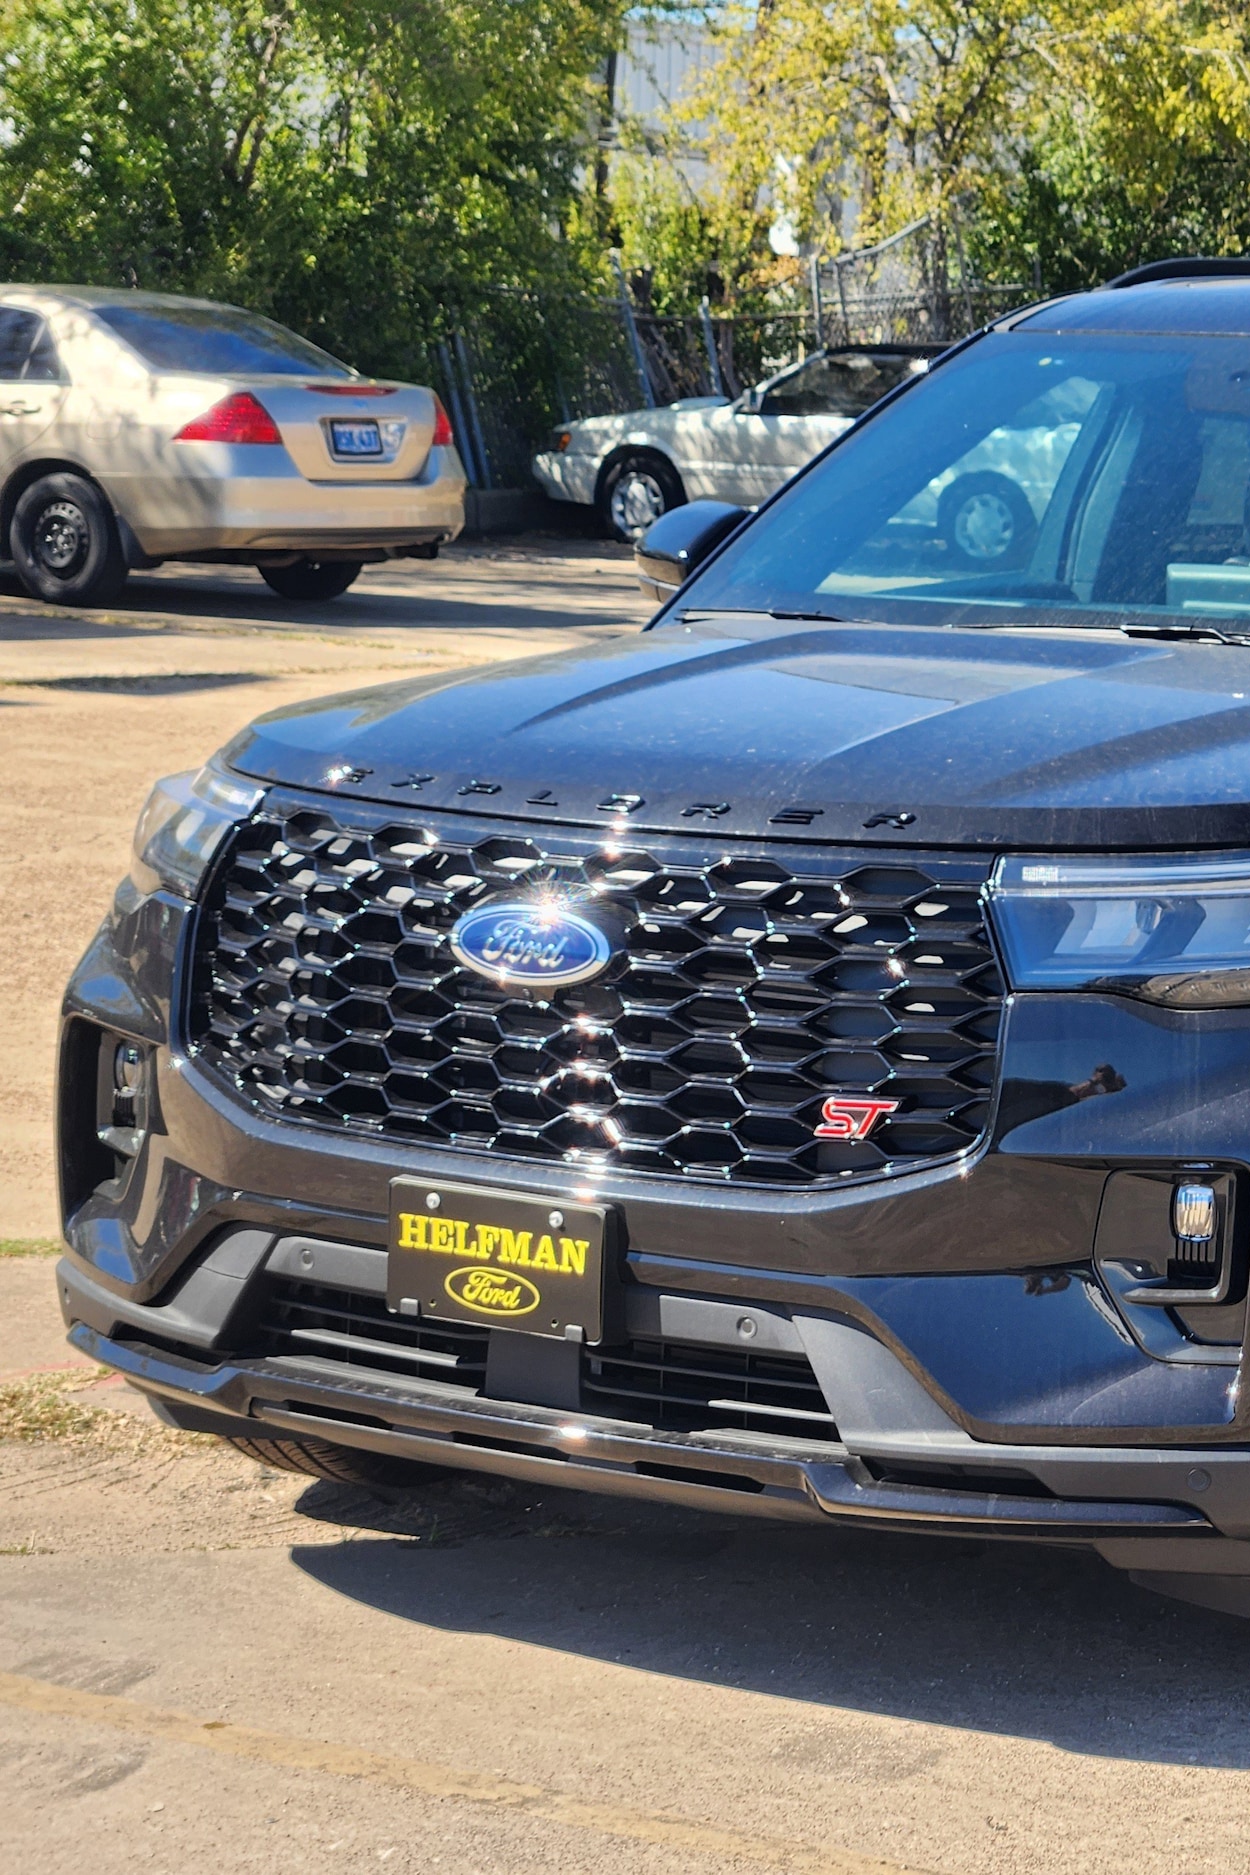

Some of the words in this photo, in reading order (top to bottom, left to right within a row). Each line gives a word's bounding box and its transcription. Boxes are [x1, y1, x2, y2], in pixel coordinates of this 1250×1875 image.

[322, 765, 917, 830] EXPLORER
[482, 919, 570, 968] Ford
[813, 1096, 899, 1140] ST
[398, 1213, 590, 1275] HELFMAN
[462, 1271, 522, 1309] Ford
